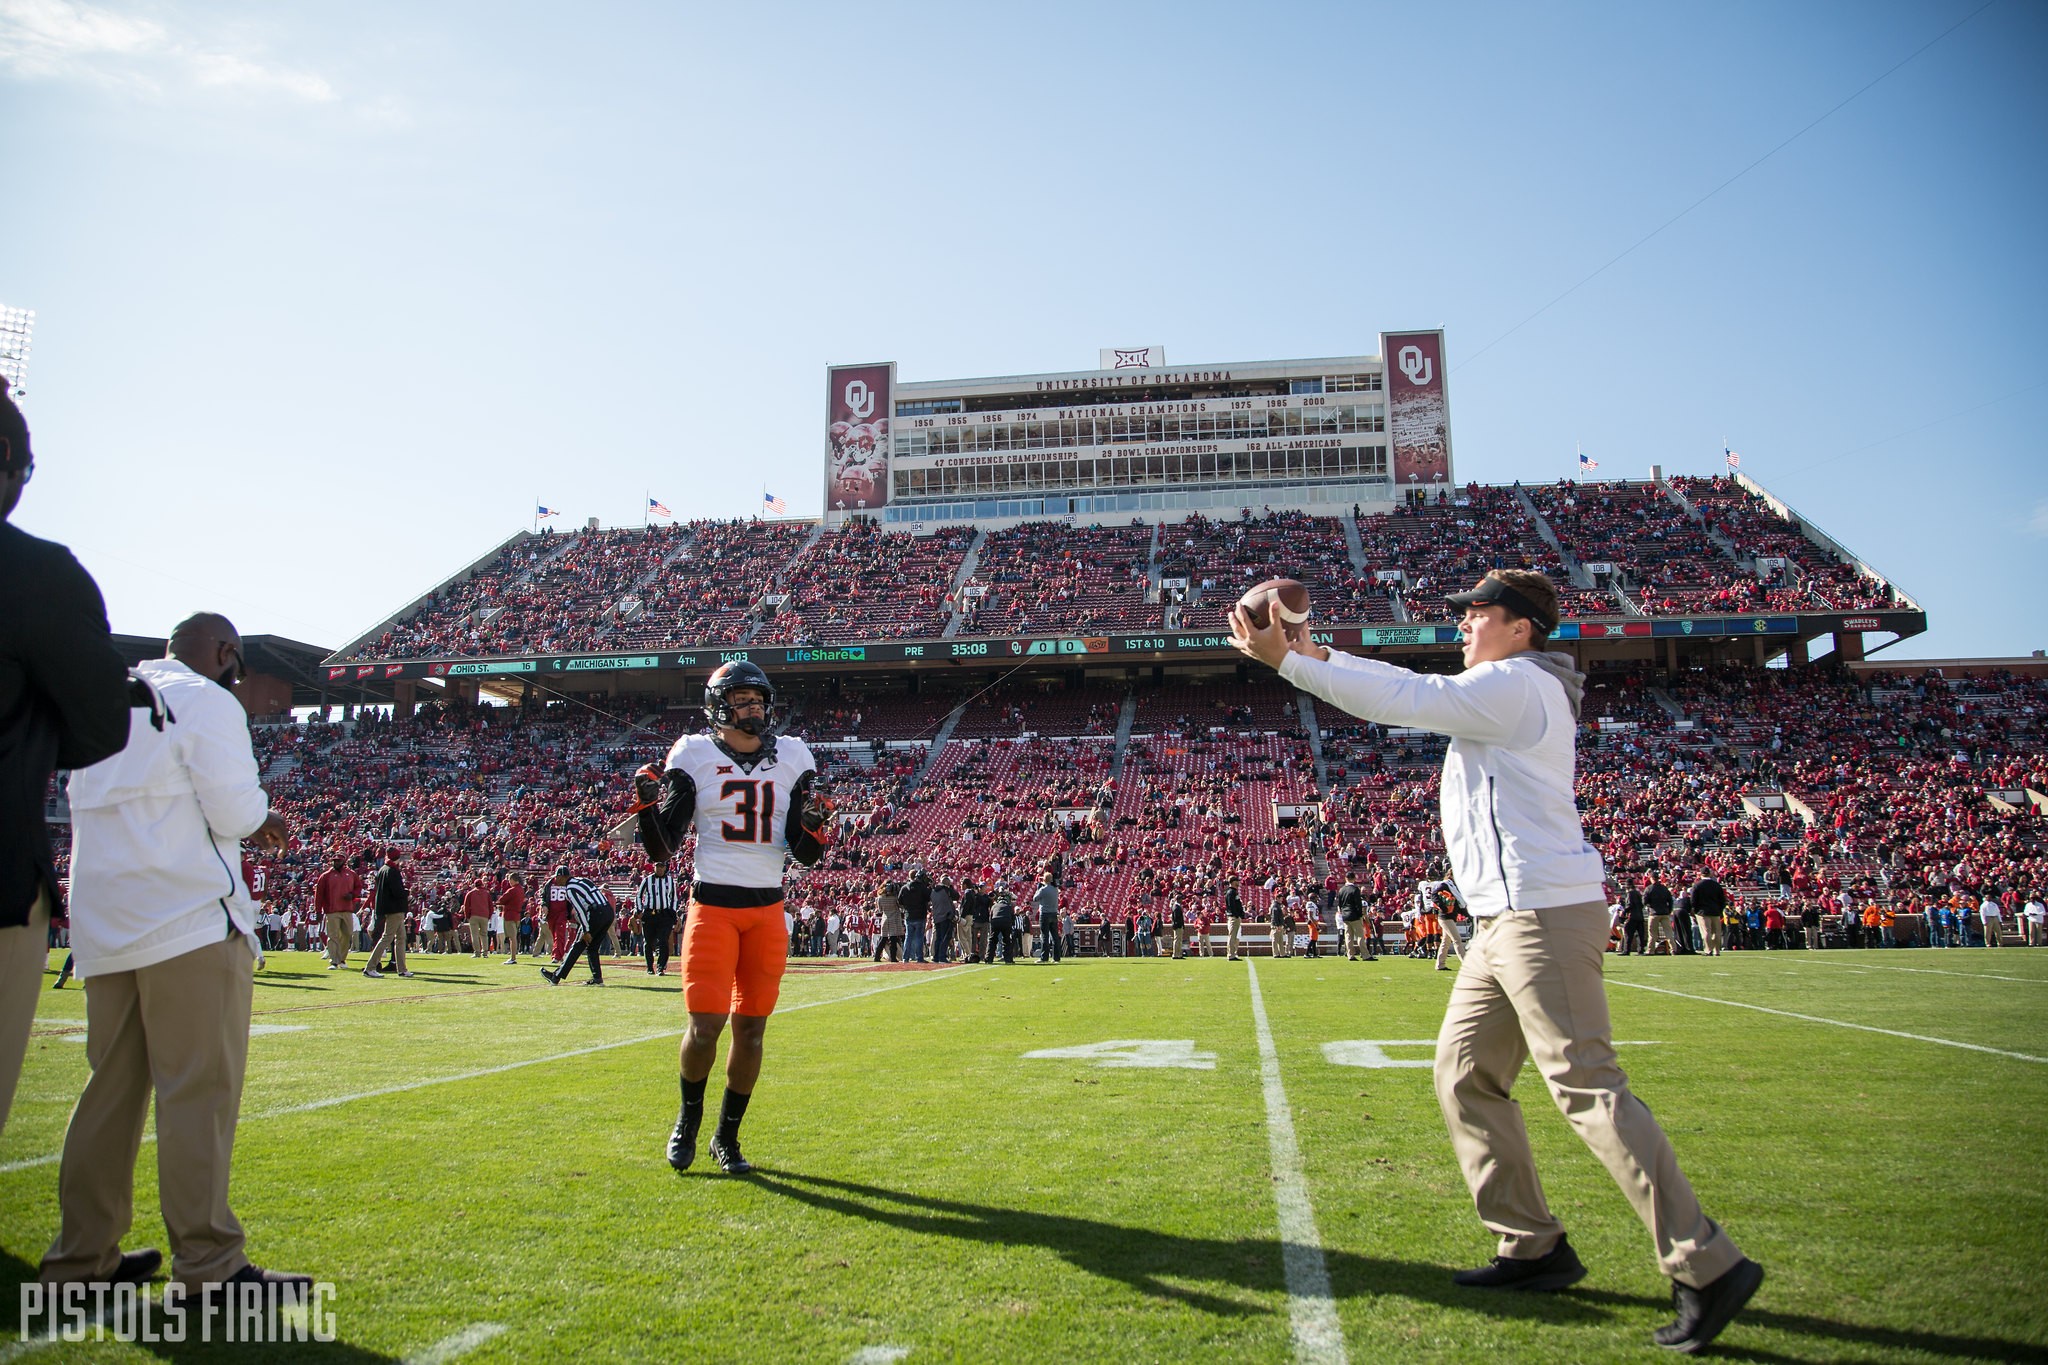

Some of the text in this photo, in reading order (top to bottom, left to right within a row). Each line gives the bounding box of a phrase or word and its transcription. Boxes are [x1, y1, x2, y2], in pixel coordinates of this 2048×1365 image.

[1398, 345, 1433, 386] OU
[1036, 371, 1232, 391] UNIVERSITY OF OKLAHOMA
[845, 379, 875, 419] OU
[914, 397, 1325, 427] 1950 1955 1956 1974 NATIONAL CHAMPIONS 1975 1985 2000
[1102, 444, 1218, 458] 29 BOWL CHAMPIONSHIPS
[1246, 439, 1342, 452] 162 ALL-AMERICANS
[934, 452, 1078, 468] 47 CONFERENCE CHAMPIONSHIPS
[1311, 633, 1333, 643] AN
[1376, 628, 1421, 637] CONFERENCE
[1125, 639, 1141, 649] 1ST
[1144, 640, 1151, 648] &
[1152, 639, 1165, 649] 10
[1178, 638, 1202, 647] BALL
[1204, 638, 1218, 647] ON
[1378, 635, 1419, 644] STANDINGS
[905, 643, 987, 656] PRE 35:08
[1012, 641, 1022, 655] OU
[1039, 642, 1047, 652] 0
[1066, 642, 1074, 652] 0
[678, 652, 748, 665] 4TH 14:03
[786, 649, 850, 662] LifeShare
[456, 664, 476, 673] OHIO
[478, 664, 490, 672] ST.
[574, 660, 615, 668] MICHIGAN
[617, 659, 630, 667] ST.
[1759, 797, 1766, 807] 8
[720, 779, 775, 843] 31
[1294, 807, 1300, 816] 6
[550, 889, 566, 901] 86
[1019, 1039, 1218, 1070] 4
